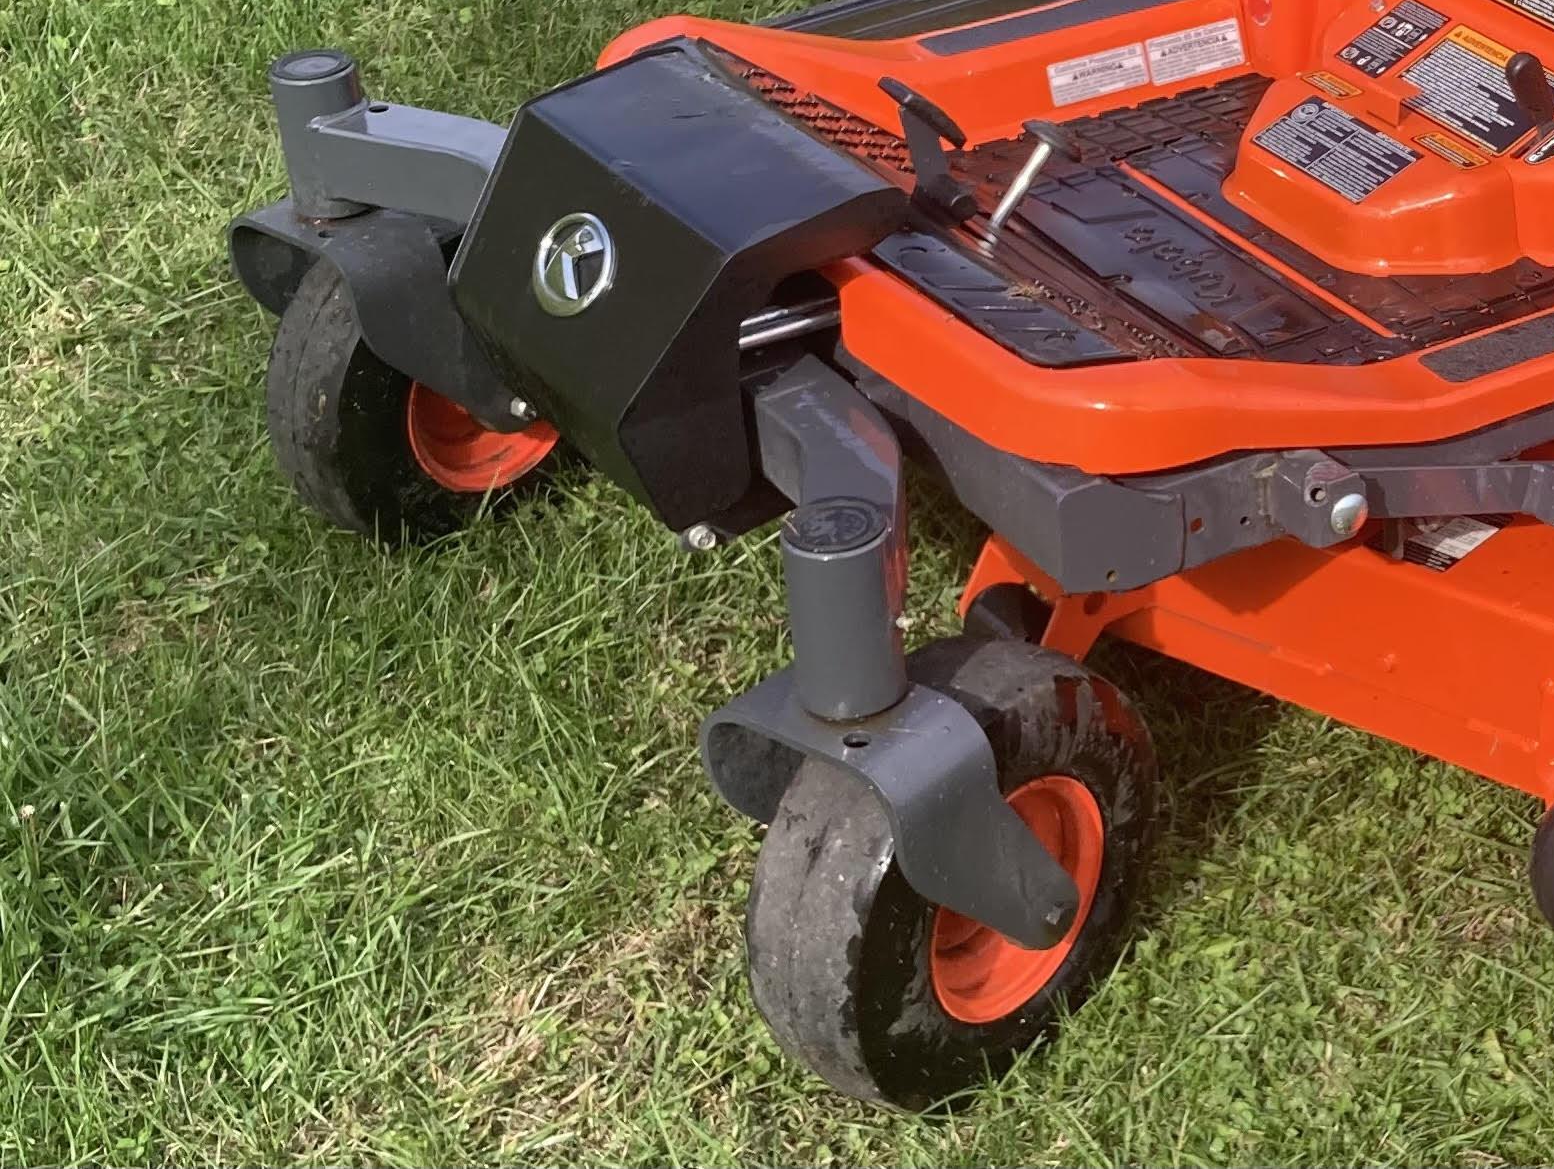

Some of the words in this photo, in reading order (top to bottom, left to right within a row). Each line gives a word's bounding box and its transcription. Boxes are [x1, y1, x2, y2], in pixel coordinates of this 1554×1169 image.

[1168, 35, 1220, 55] ADVERTENCIA
[1079, 63, 1118, 79] WARNING
[1123, 225, 1240, 308] Kubota
